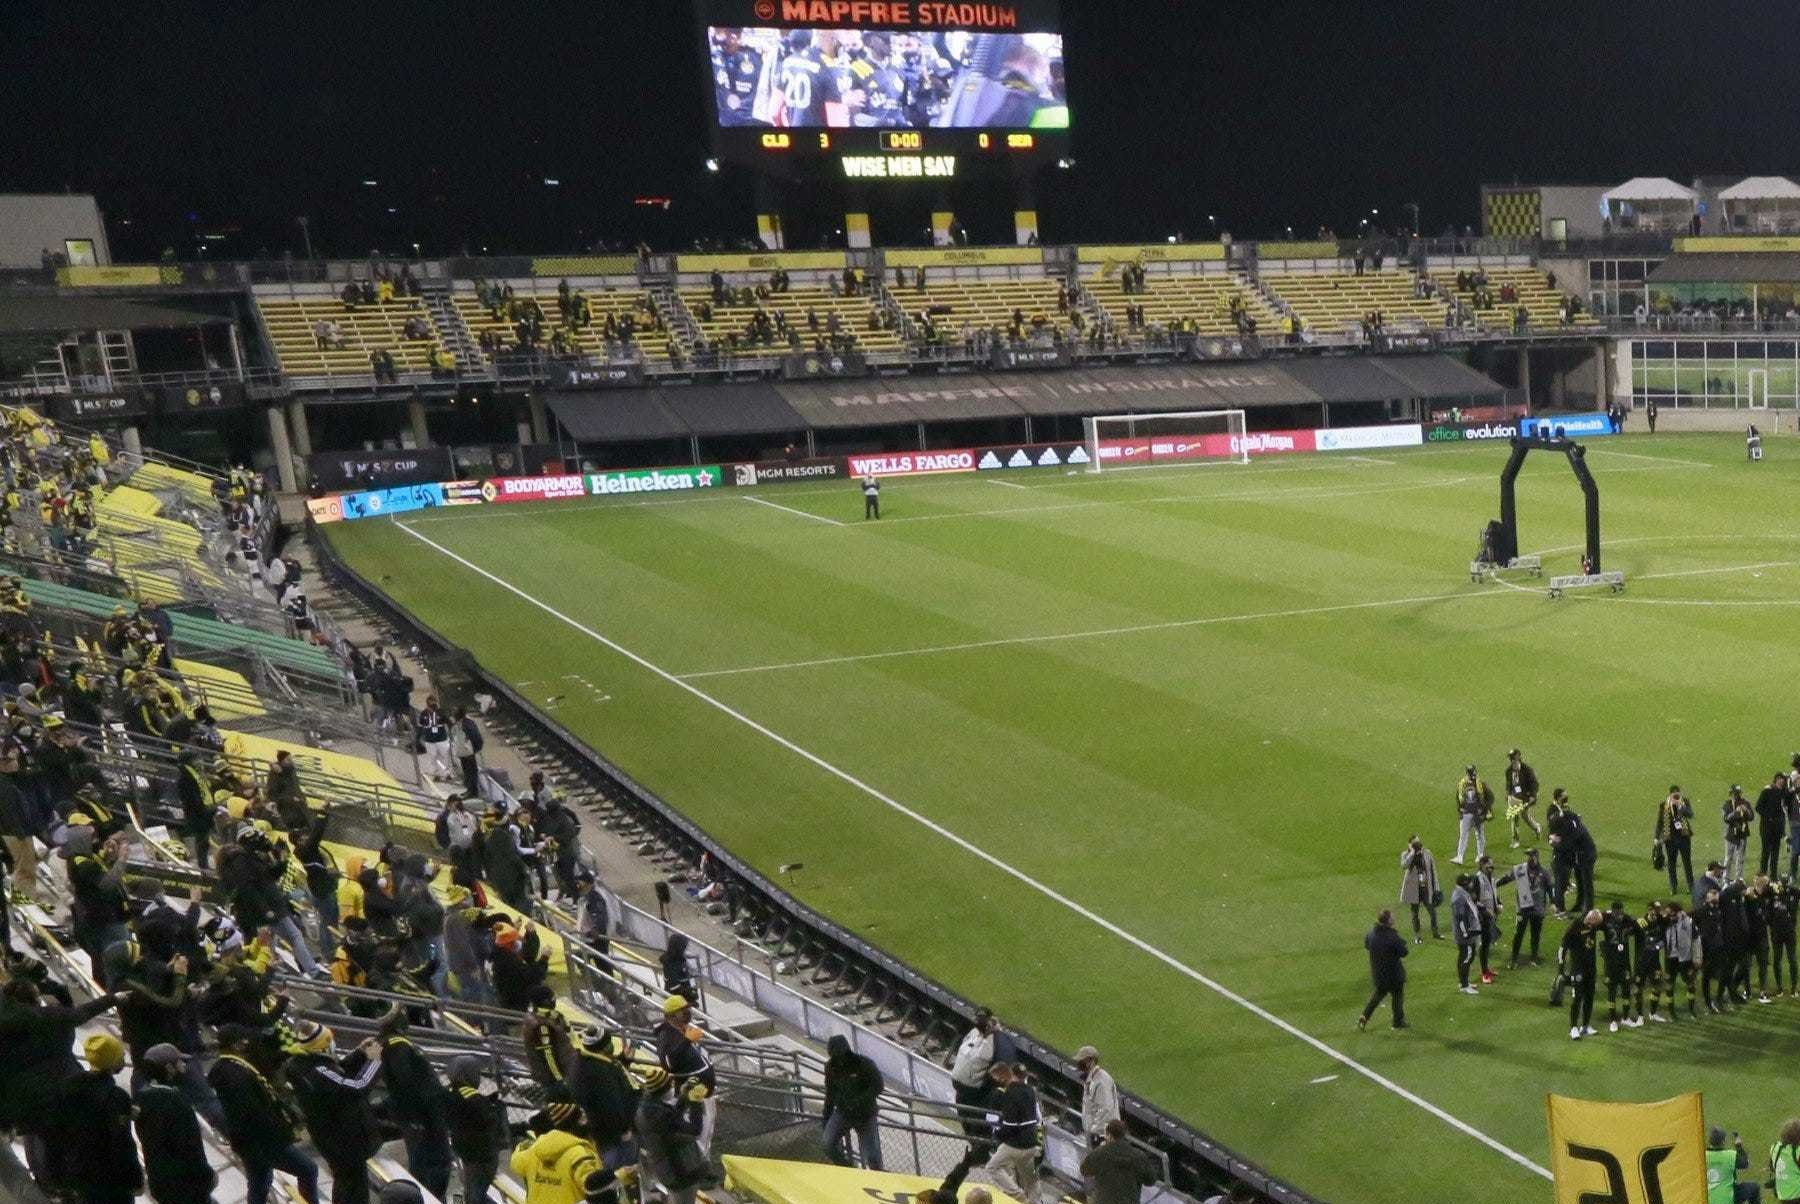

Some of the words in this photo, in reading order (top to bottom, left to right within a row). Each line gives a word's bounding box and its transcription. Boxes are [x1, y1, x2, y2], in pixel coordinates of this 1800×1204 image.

[782, 0, 911, 23] MAPFRE
[918, 4, 1016, 26] STADIUM
[820, 134, 829, 148] 3
[979, 134, 989, 148] 0
[842, 157, 887, 176] WISE
[888, 157, 922, 176] MEN
[923, 156, 955, 176] SAY
[1428, 428, 1460, 441] office
[852, 455, 912, 473] WELLS
[915, 452, 974, 470] FARGO
[757, 468, 784, 479] MGM
[786, 464, 836, 477] RESORTS
[504, 476, 583, 493] BODYARMOR
[591, 471, 694, 495] Heineken
